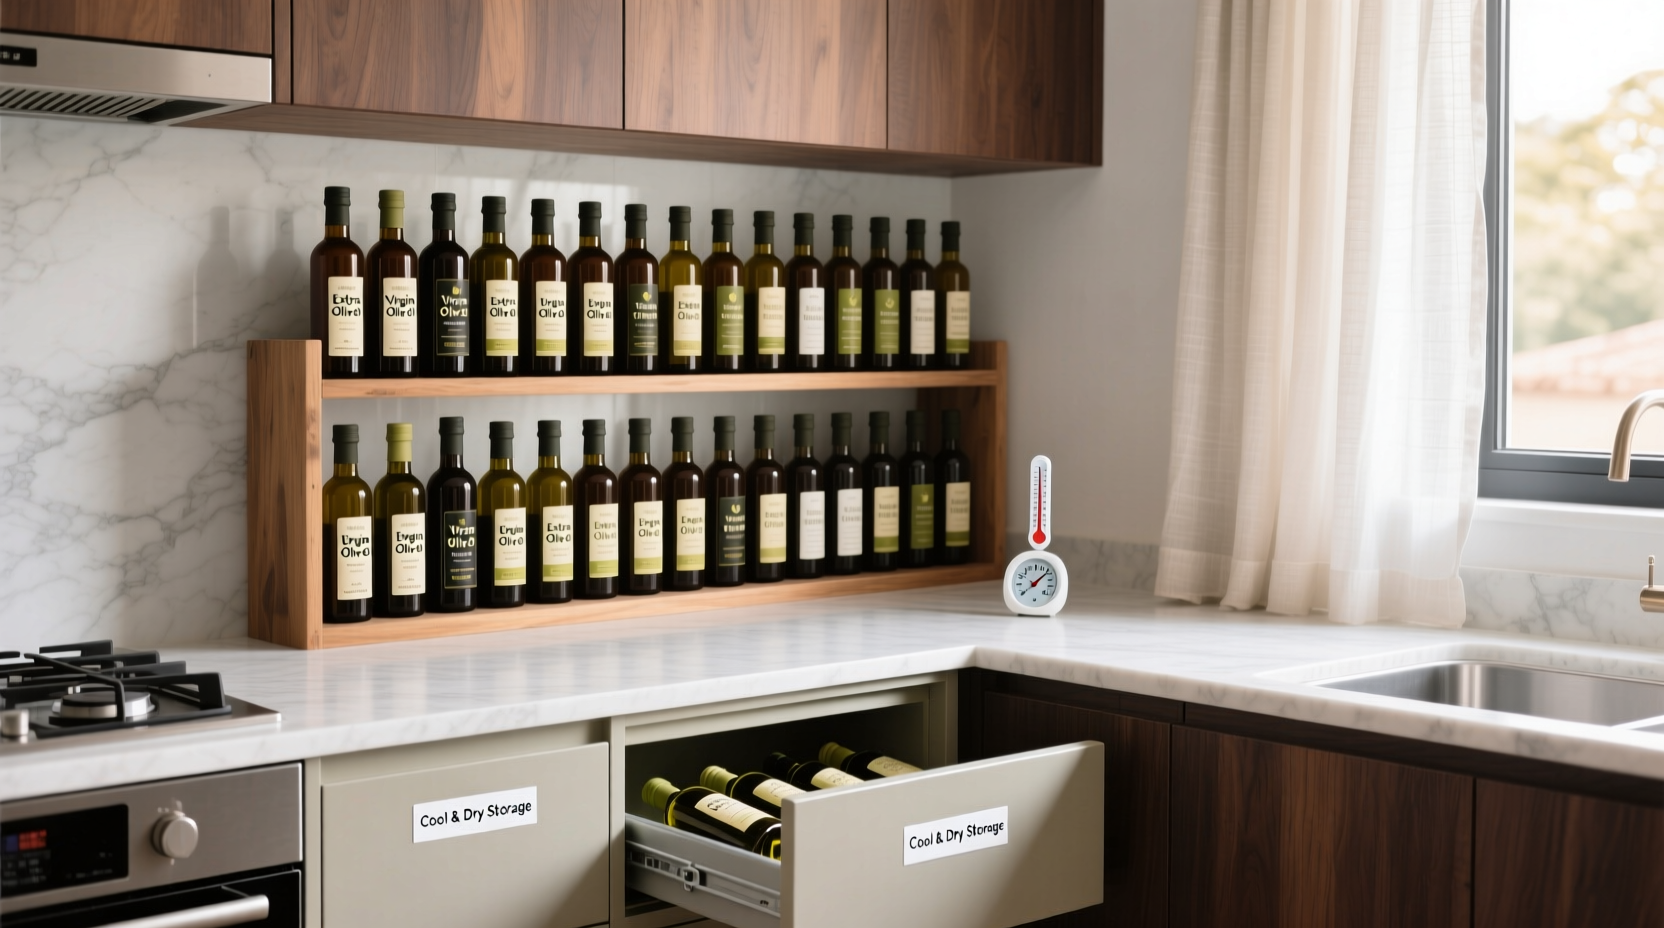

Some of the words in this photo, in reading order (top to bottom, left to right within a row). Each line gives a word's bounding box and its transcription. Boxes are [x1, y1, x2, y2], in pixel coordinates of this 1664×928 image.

[385, 294, 415, 307] Virgin
[421, 810, 448, 828] Cool
[452, 810, 460, 823] &
[463, 807, 484, 823] Dry
[487, 802, 532, 818] Storage
[909, 830, 933, 850] Cool
[936, 831, 944, 844] &
[946, 829, 963, 843] Dry
[966, 822, 1004, 838] Storage
